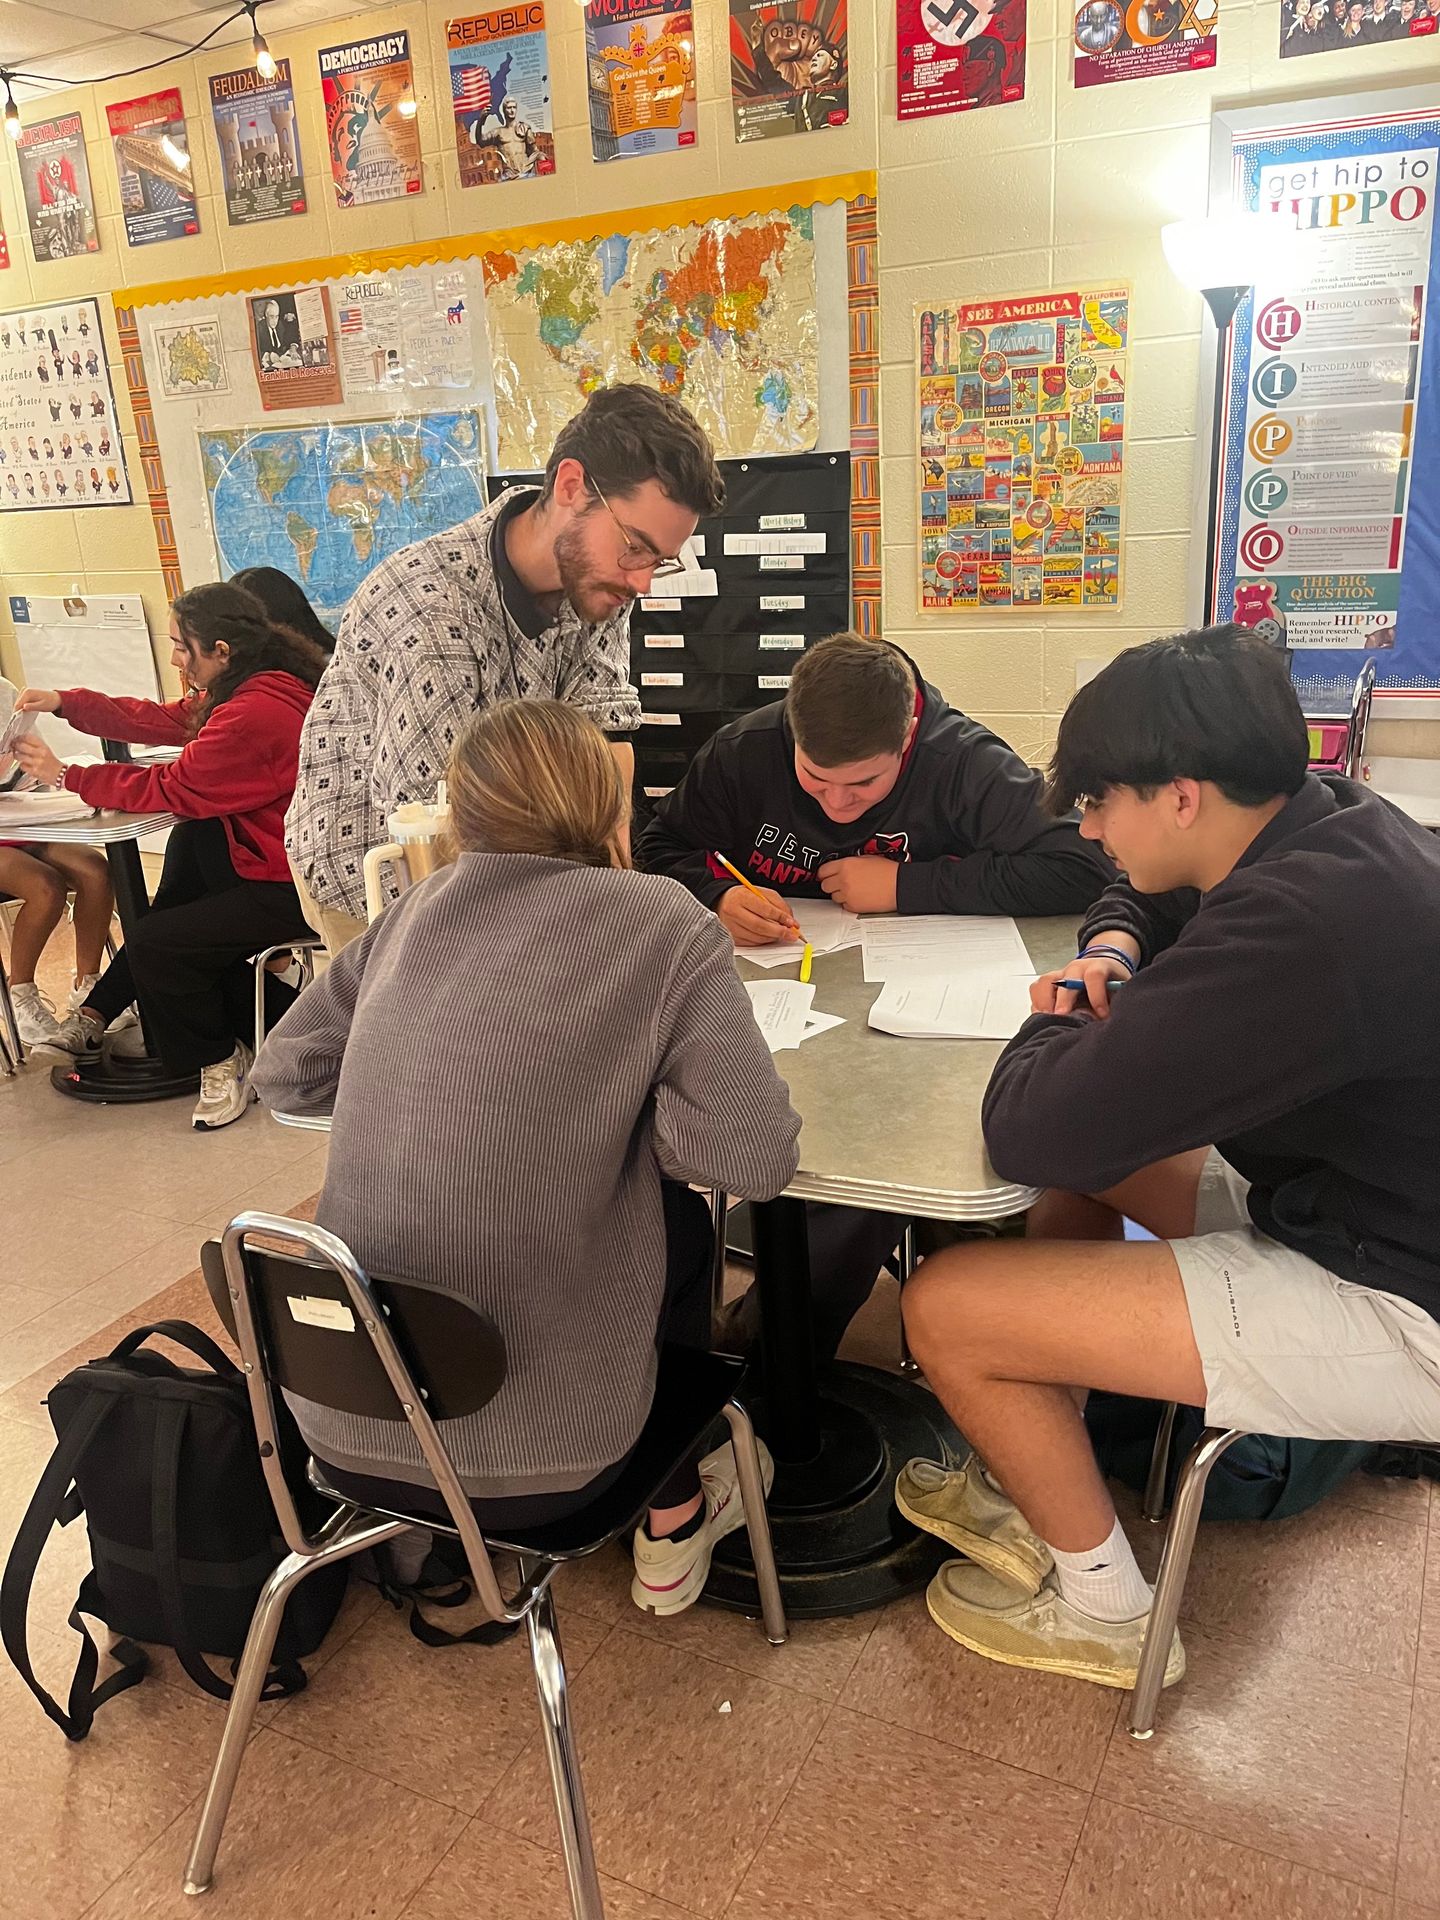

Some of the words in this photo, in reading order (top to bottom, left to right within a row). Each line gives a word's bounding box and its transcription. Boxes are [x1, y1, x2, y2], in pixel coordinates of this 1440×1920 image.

[587, 0, 681, 18] Monay
[447, 6, 543, 42] REPUBLIC
[770, 26, 819, 44] OBEY
[321, 36, 406, 72] DEMOCRACY
[1099, 49, 1136, 61] SEPARATION
[1145, 43, 1172, 54] CHURCH
[1187, 37, 1205, 46] STATE
[614, 72, 625, 81] God
[626, 70, 639, 79] Save
[639, 68, 648, 76] the
[648, 65, 667, 75] Queen
[17, 116, 81, 148] SOCIALISM
[1268, 166, 1318, 199] get
[1335, 162, 1383, 188] hip
[1399, 157, 1429, 180] to
[1084, 291, 1126, 301] CALIFORNIA
[966, 308, 994, 321] SEE
[1000, 299, 1073, 318] AMERICA
[1305, 299, 1362, 311] HISTORICAL
[1268, 310, 1295, 339] H
[922, 312, 933, 374] ALASKA
[990, 334, 1050, 353] HAWAII
[259, 368, 289, 382] Franklin
[299, 363, 336, 378] Roosevelt
[1301, 362, 1348, 372] INTENDED
[985, 405, 1010, 413] OREGON
[0, 417, 36, 431] America
[989, 418, 1031, 427] MICHIGAN
[1261, 424, 1286, 452] P
[1083, 462, 1121, 473] MONTANA
[1292, 470, 1322, 480] POINT
[1322, 471, 1334, 479] OF
[1335, 470, 1360, 479] VIEW
[1258, 481, 1283, 506] P
[762, 517, 781, 526] World
[1288, 525, 1328, 535] OUTSIDE
[1329, 524, 1390, 535] INFORMATION
[1055, 544, 1082, 552] Delaware
[763, 557, 788, 567] Monday
[1300, 576, 1334, 588] THE
[1338, 575, 1367, 586] BIG
[1290, 587, 1376, 602] QUESTION
[763, 598, 789, 607] Tuesday
[925, 597, 950, 606] MAINE
[1334, 614, 1388, 626] HIPPO
[1325, 627, 1362, 635] research,
[762, 638, 794, 647] Wednesday
[1288, 636, 1307, 644] read,
[761, 678, 792, 688] Thursday
[755, 823, 839, 870] PET
